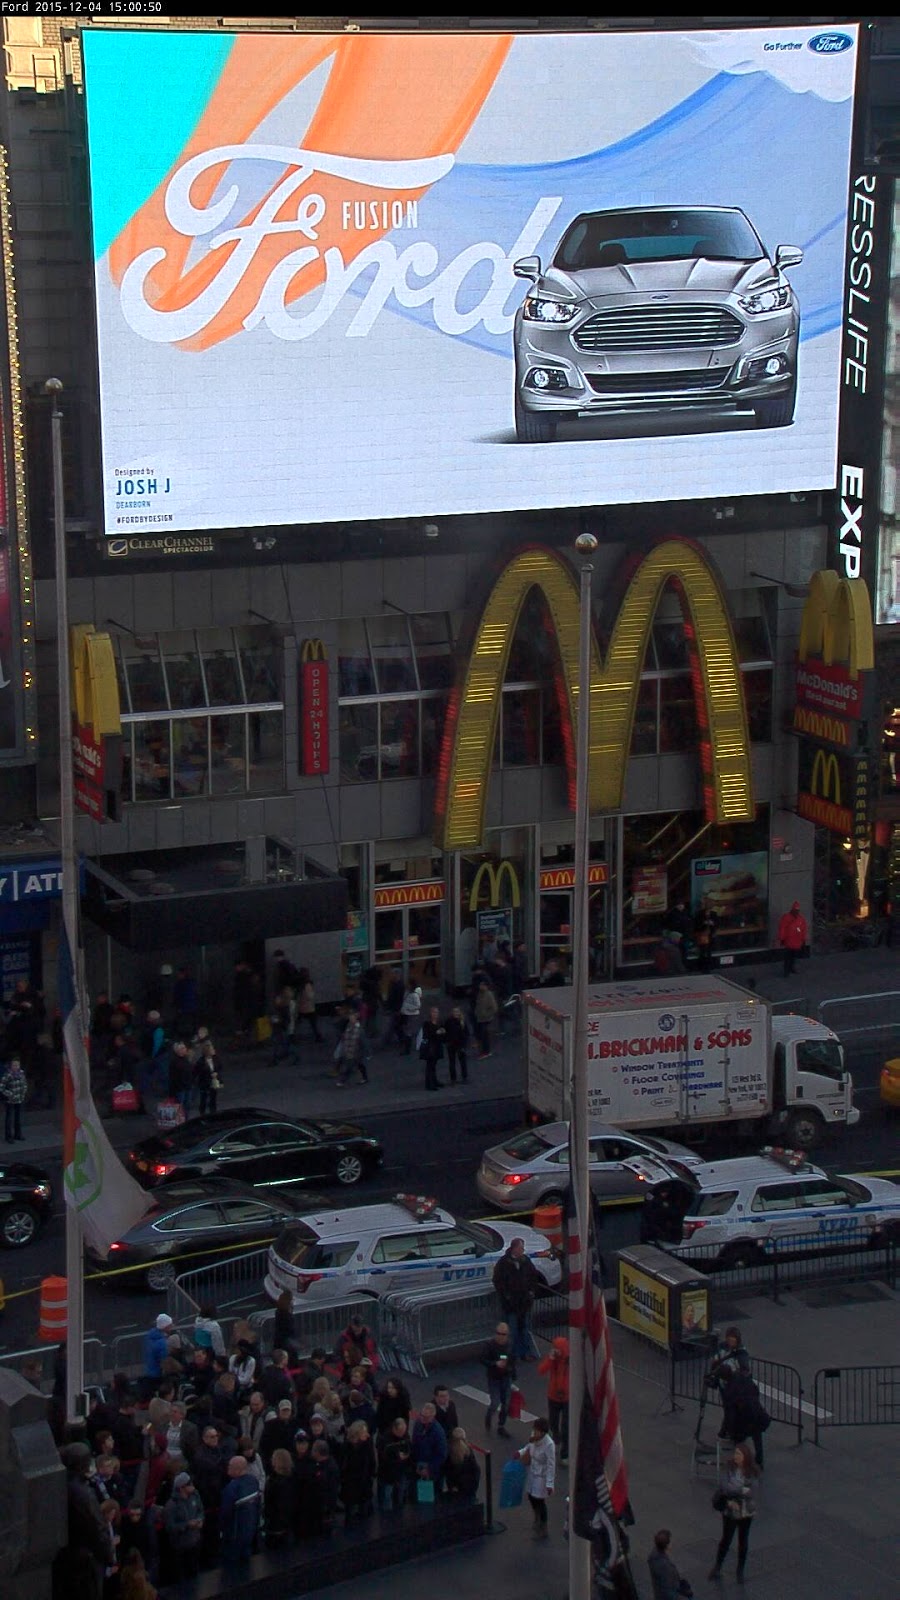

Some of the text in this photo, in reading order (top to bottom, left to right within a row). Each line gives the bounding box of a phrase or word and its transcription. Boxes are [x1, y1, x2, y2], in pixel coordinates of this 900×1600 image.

[763, 42, 803, 51] Go Further
[816, 36, 844, 53] Ford
[341, 199, 419, 230] FUSION
[114, 467, 155, 477] Designed by
[115, 477, 170, 496] JOSH J
[115, 500, 151, 509] DEARBORN
[839, 464, 864, 579] EXP
[312, 669, 321, 706] OPEN
[797, 669, 858, 701] McDonald's
[694, 1037, 703, 1050] &
[707, 1029, 752, 1049] SONS
[620, 1064, 655, 1073] WINDOW
[631, 1076, 659, 1085] FLOOR
[641, 1087, 665, 1096] PAINT
[682, 1081, 723, 1092] HARDWARE
[818, 1216, 859, 1233] NYPD
[443, 1266, 486, 1281] NYPD
[623, 1274, 666, 1317] Beautiful
